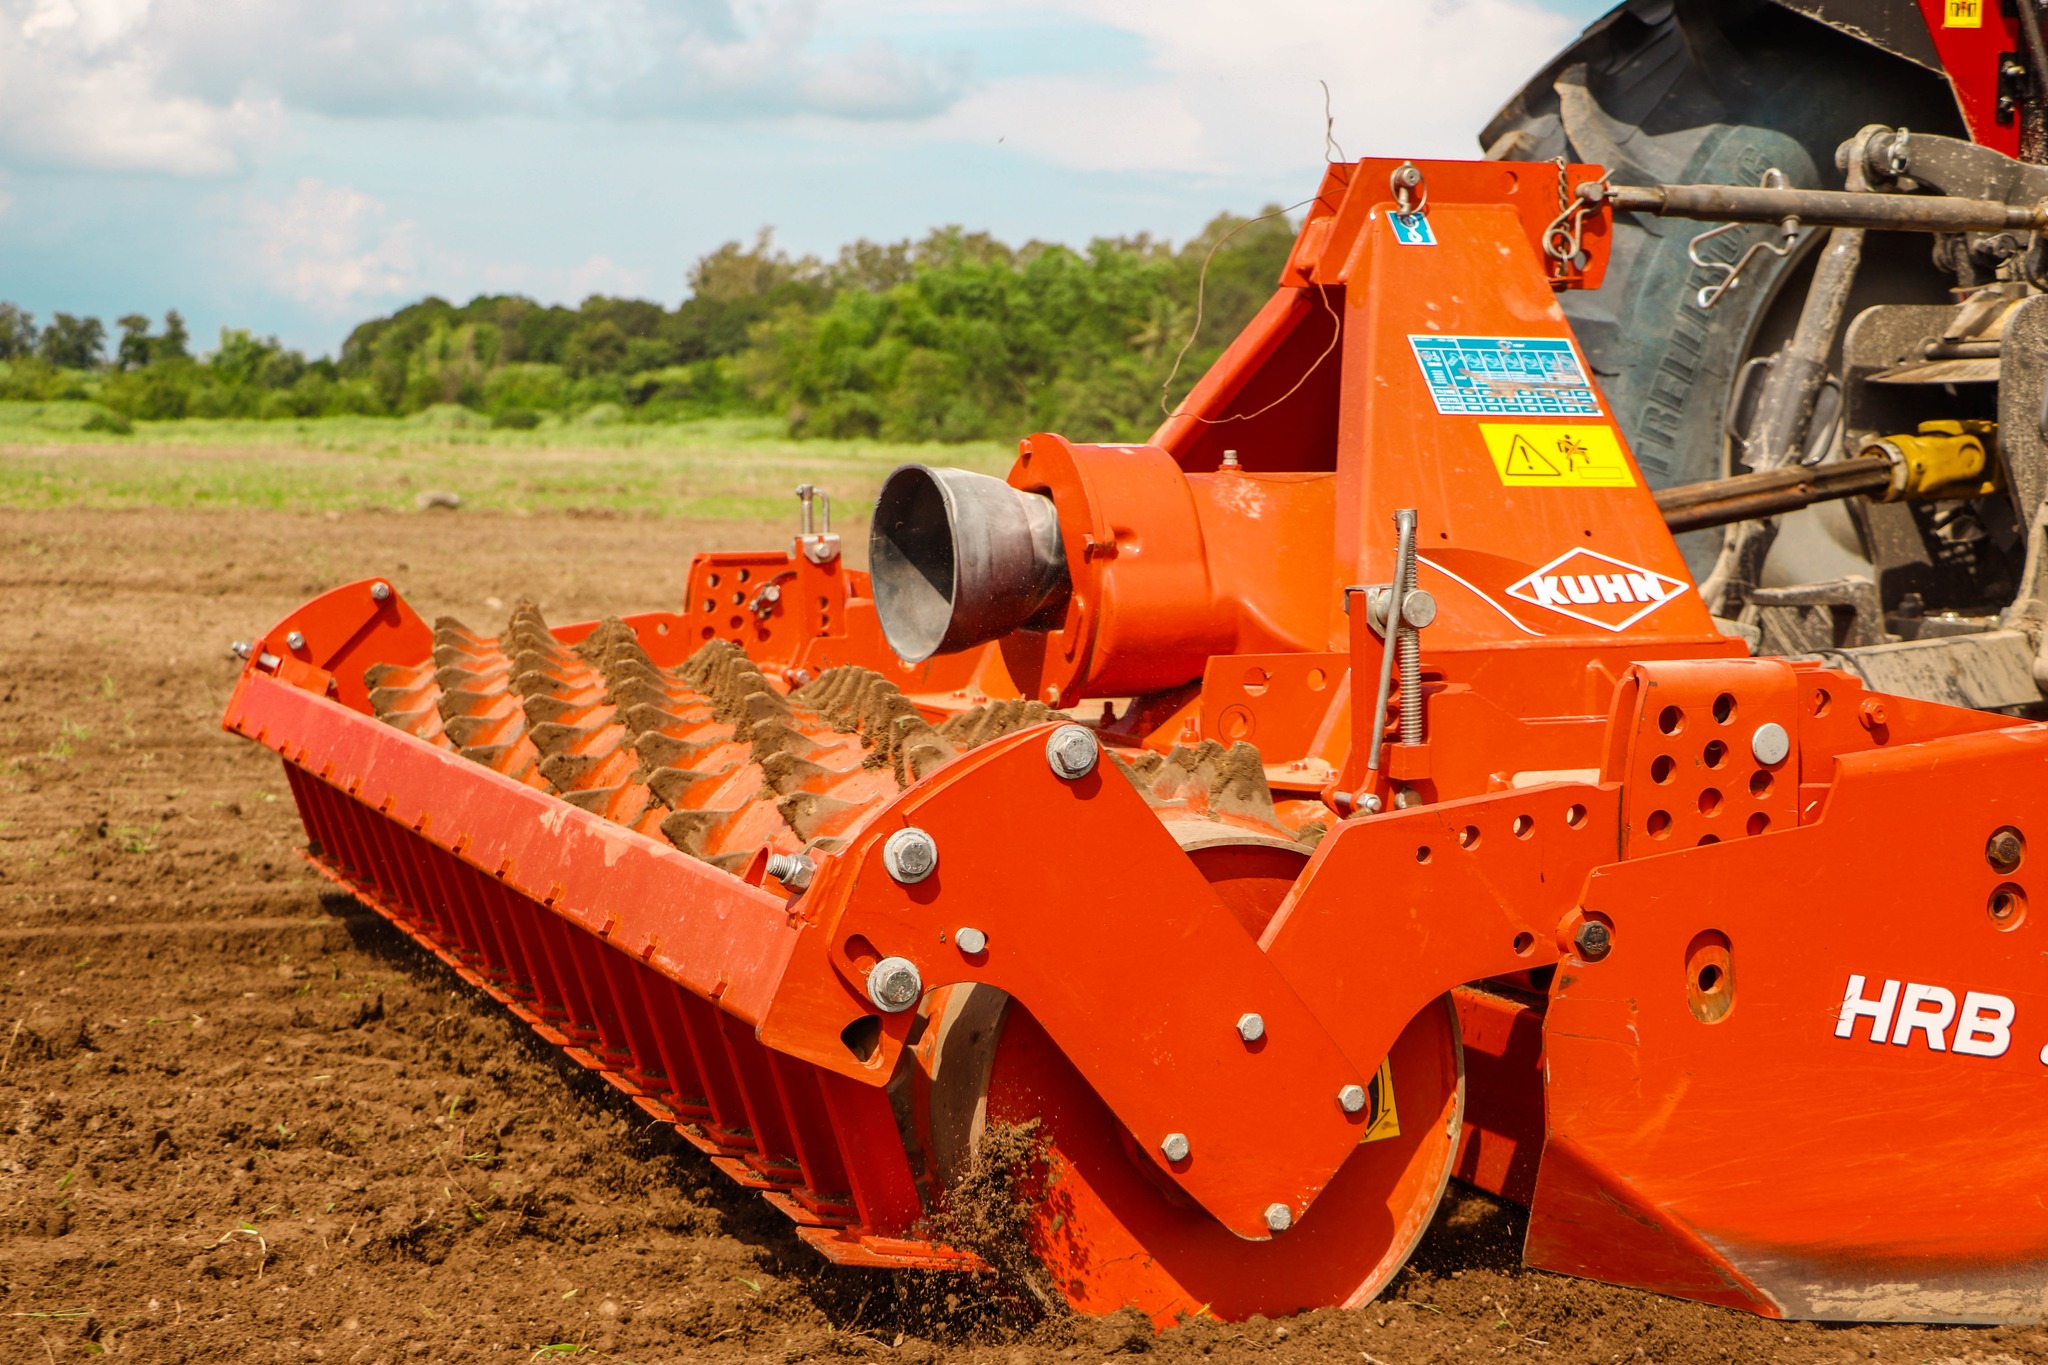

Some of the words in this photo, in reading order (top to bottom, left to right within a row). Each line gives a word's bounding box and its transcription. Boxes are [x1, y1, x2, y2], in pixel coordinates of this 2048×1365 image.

[1636, 144, 1774, 478] TRELLEBOG
[1529, 572, 1667, 605] KUHN
[1834, 974, 2016, 1058] HRB
